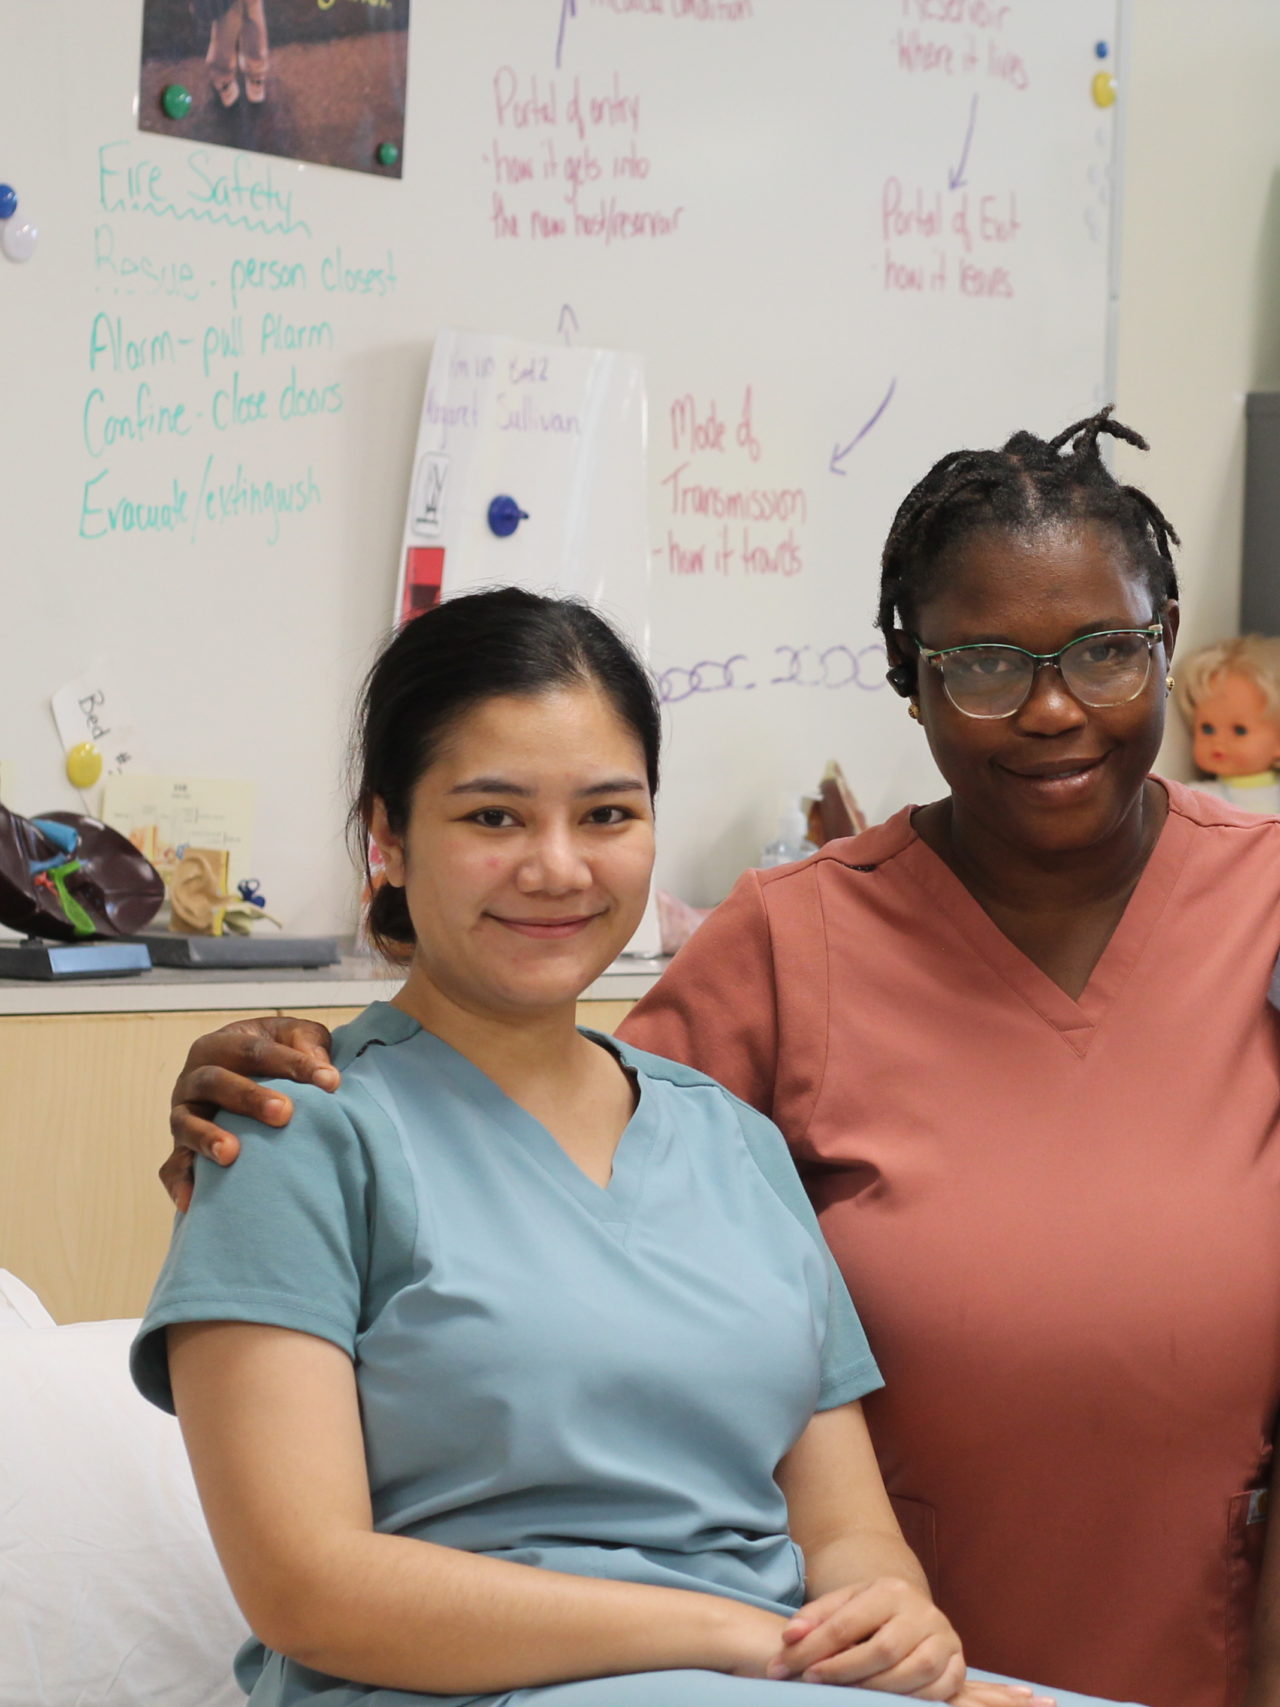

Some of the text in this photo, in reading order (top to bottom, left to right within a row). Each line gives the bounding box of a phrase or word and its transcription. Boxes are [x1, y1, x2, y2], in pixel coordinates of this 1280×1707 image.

[493, 64, 558, 129] Portal
[98, 138, 295, 230] Fire Safety
[543, 137, 559, 181] it
[563, 144, 603, 205] gets
[611, 138, 652, 181] into
[490, 190, 521, 240] the
[882, 175, 943, 242] Portal
[230, 257, 308, 310] person
[930, 247, 947, 291] it
[279, 364, 345, 422] doors
[670, 393, 727, 456] Mode
[659, 460, 808, 527] Transmission
[714, 523, 735, 578] it
[78, 689, 111, 741] Bed
